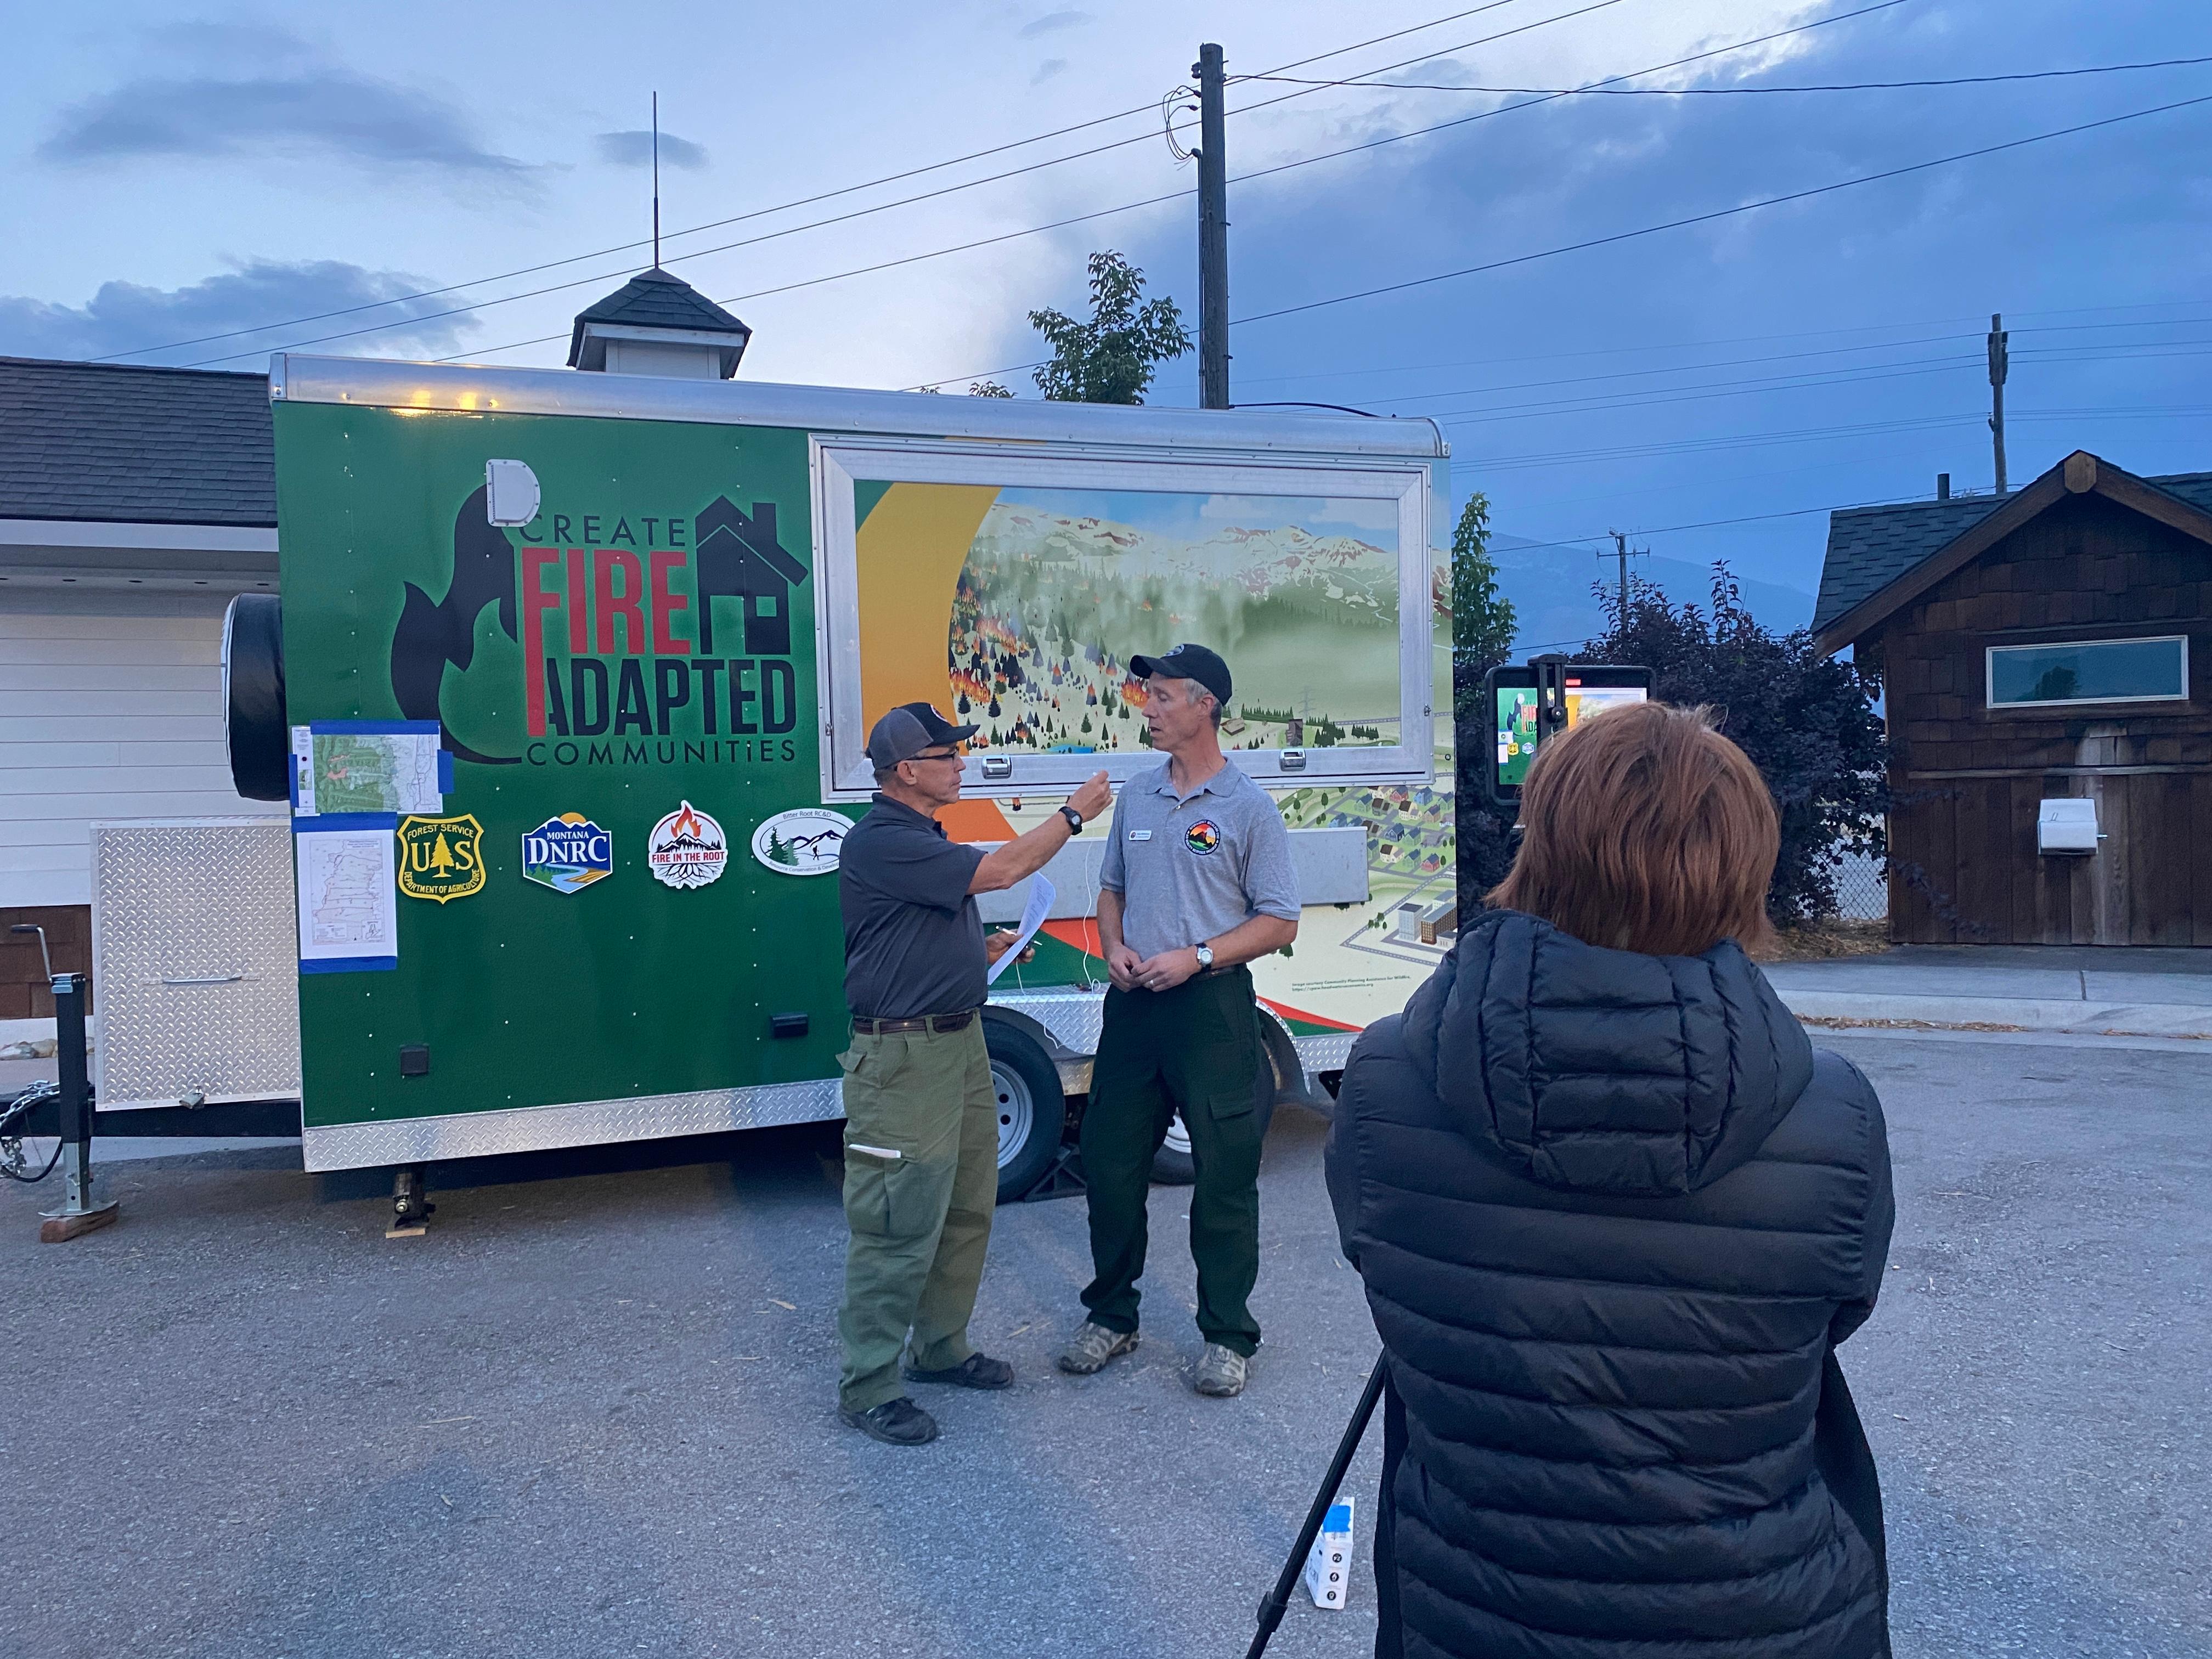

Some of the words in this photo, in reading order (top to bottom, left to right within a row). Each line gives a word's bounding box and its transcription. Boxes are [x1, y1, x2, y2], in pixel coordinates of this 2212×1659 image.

[519, 514, 685, 546] CREATE
[521, 548, 691, 736] FIRE
[547, 658, 797, 736] ADAPTED
[527, 740, 795, 766] COMMUNITIES
[407, 824, 438, 840] FOREST
[441, 824, 474, 838] SERVICE
[547, 831, 589, 840] MONTANA
[528, 836, 608, 865] DNRC
[652, 854, 670, 863] FIRE
[673, 853, 682, 862] IN
[684, 852, 701, 861] THE
[703, 851, 724, 861] ROOT
[769, 861, 788, 871] Resource
[404, 871, 438, 894] DEPARTMENT
[439, 885, 447, 894] OF
[448, 869, 479, 893] AGRICULTURE
